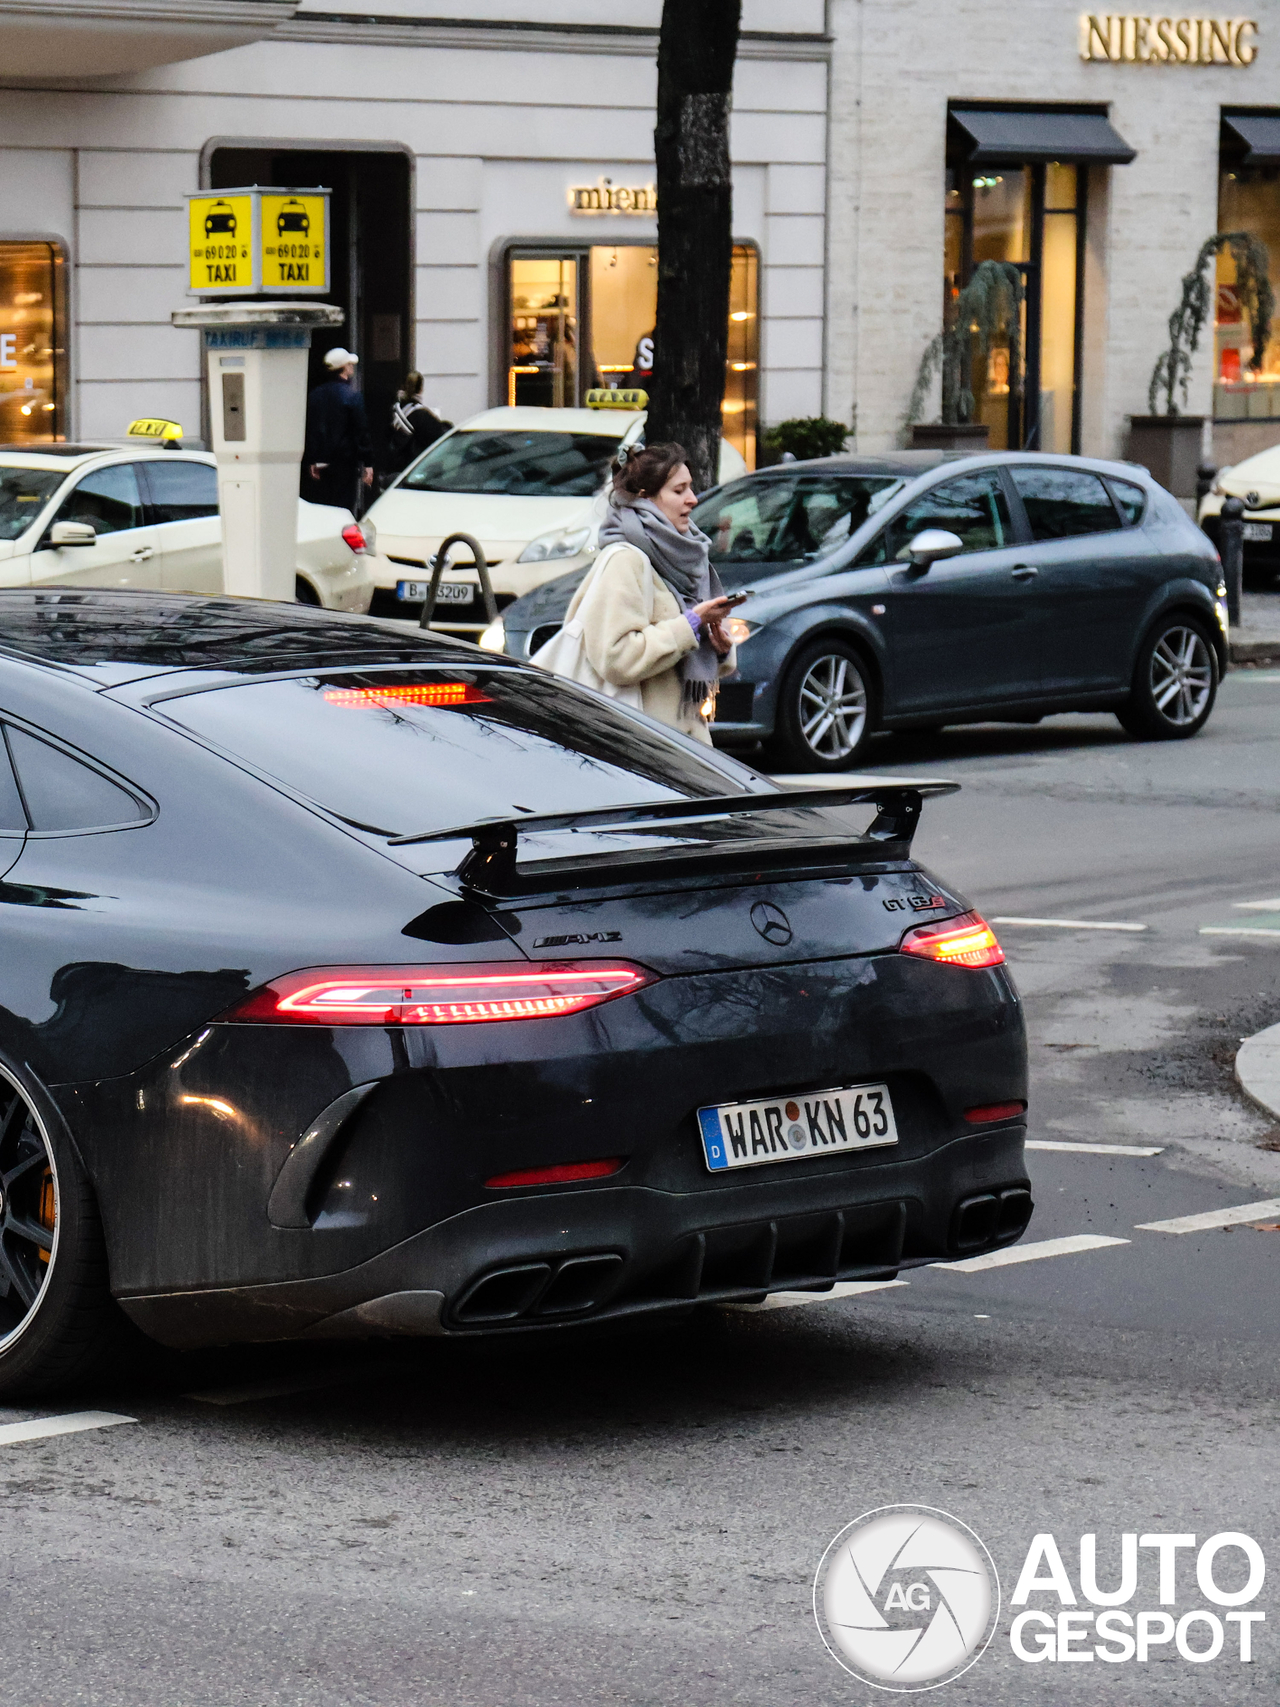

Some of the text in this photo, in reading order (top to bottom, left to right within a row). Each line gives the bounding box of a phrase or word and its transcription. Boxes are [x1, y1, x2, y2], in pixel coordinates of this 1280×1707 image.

[1080, 15, 1259, 67] NIESSING
[206, 263, 236, 281] TAXI
[278, 263, 309, 280] TAXI
[725, 1092, 888, 1158] WAR KN 63
[711, 1145, 721, 1159] D
